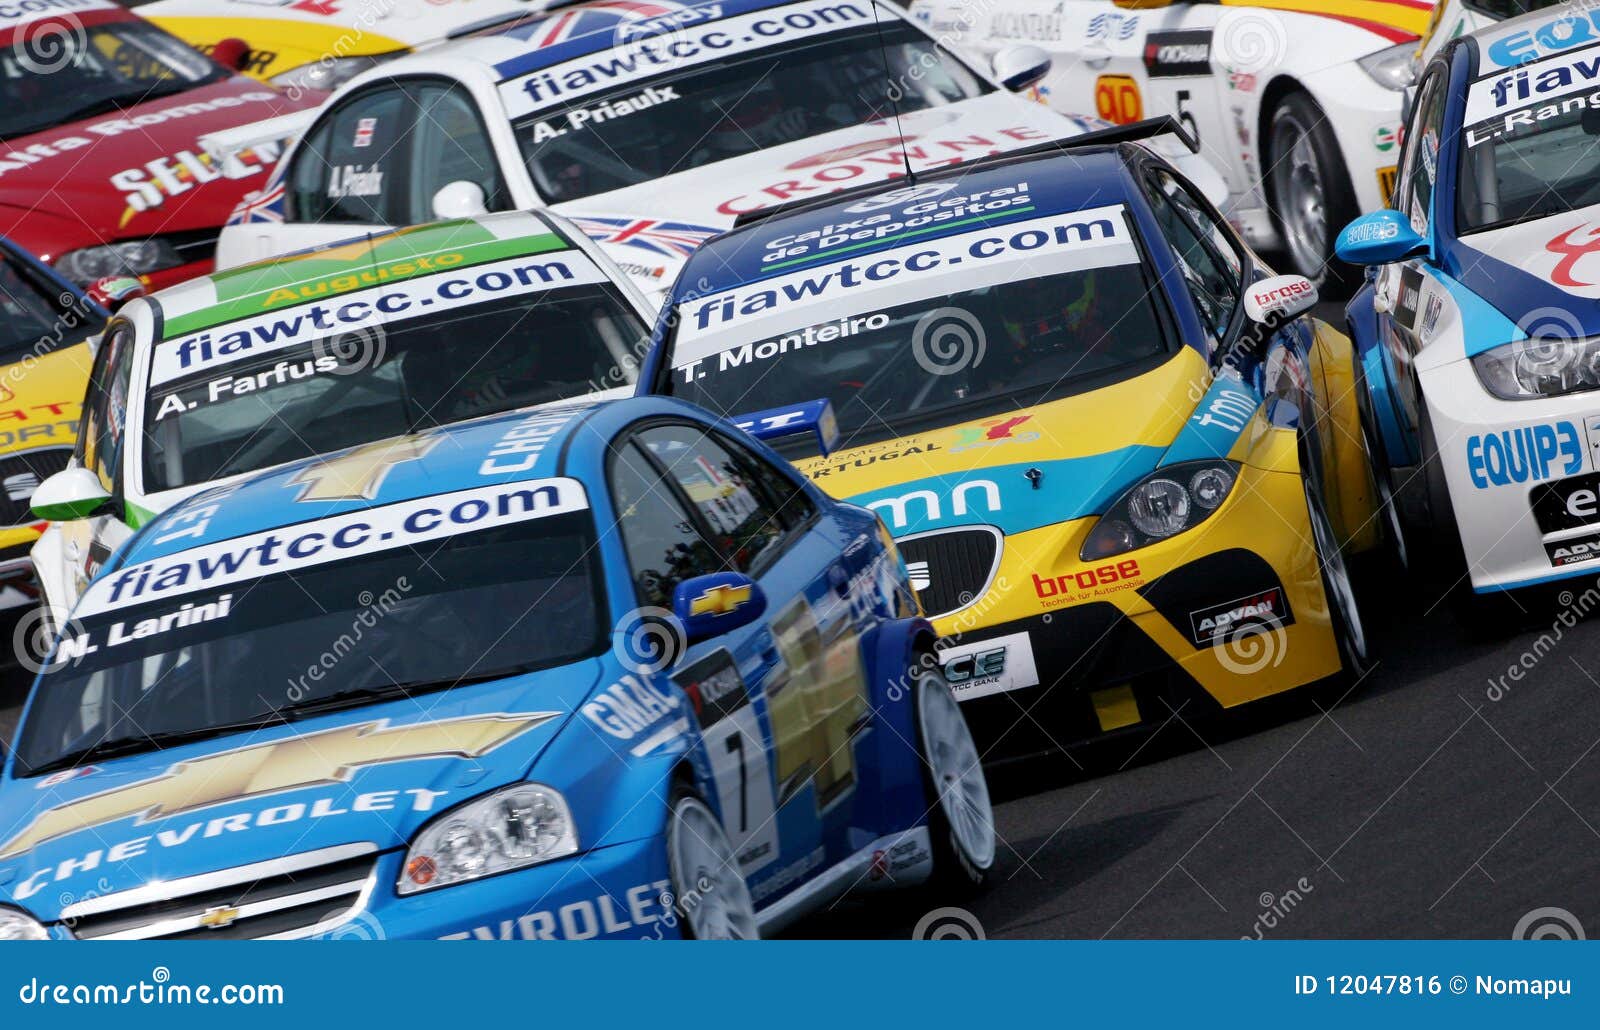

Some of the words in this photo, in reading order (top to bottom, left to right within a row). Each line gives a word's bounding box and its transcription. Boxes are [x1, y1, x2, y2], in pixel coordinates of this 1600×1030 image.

[523, 2, 868, 102] fiawtcc.com
[86, 91, 278, 136] Romeo
[533, 122, 566, 145] A.
[570, 84, 681, 132] Priaulx
[716, 125, 1049, 217] CROWNE
[766, 212, 891, 249] Caixa
[903, 182, 1029, 216] Geral
[263, 252, 464, 308] Augusto
[694, 218, 1115, 330] fiawtcc.com
[761, 243, 809, 263] de
[176, 261, 575, 369] fiawtcc.com
[1255, 281, 1312, 306] brose
[678, 360, 706, 384] T.
[719, 312, 890, 371] Monteiro
[155, 393, 197, 421] A.
[209, 355, 339, 402] Farfus
[107, 485, 560, 603] fiawtcc.com
[1032, 559, 1141, 598] brose
[1041, 595, 1077, 608] Technik
[1094, 579, 1145, 596] Automobile
[55, 635, 98, 664] N.
[107, 594, 233, 647] Larini
[1199, 600, 1273, 632] ADVAN
[581, 664, 680, 740] GMAC
[725, 731, 748, 833] 7
[12, 789, 450, 900] CHEVROLET
